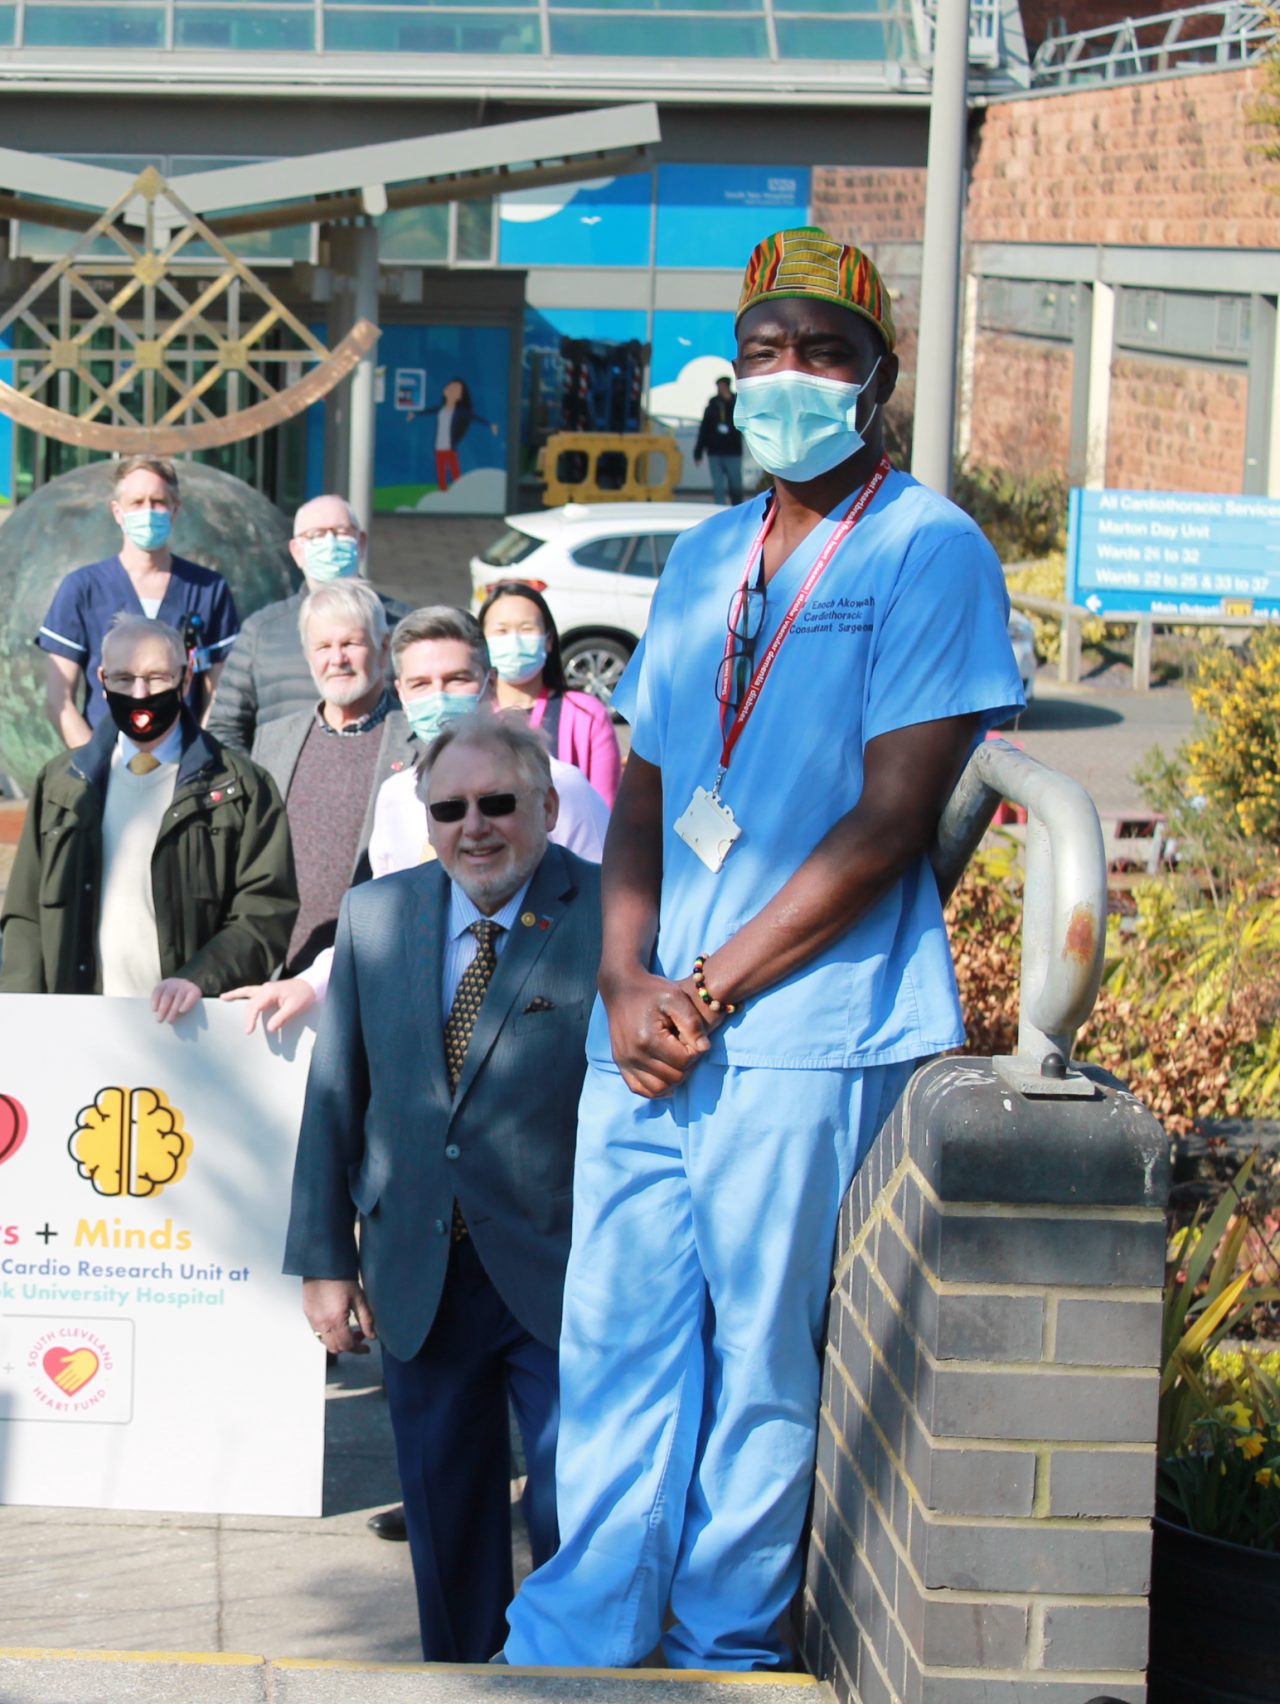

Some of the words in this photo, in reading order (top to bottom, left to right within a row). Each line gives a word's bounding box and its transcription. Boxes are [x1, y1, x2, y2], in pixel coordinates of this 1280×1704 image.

[1151, 521, 1178, 540] Day
[1181, 523, 1210, 539] Unit
[1163, 547, 1179, 563] to
[1163, 572, 1178, 588] to
[1234, 576, 1249, 592] to
[838, 622, 874, 634] Surgeon
[752, 650, 776, 686] dementia
[74, 1218, 193, 1251] Minds
[1, 1258, 71, 1276] Cardio
[78, 1260, 173, 1279] Research
[180, 1263, 223, 1280] Unit
[228, 1267, 250, 1282] at
[23, 1283, 130, 1307] University
[136, 1286, 225, 1309] Hospital
[27, 1331, 56, 1367] SOUTH
[59, 1327, 113, 1370] CLEVELAND
[33, 1386, 69, 1412] HEART
[74, 1388, 106, 1412] FUND
